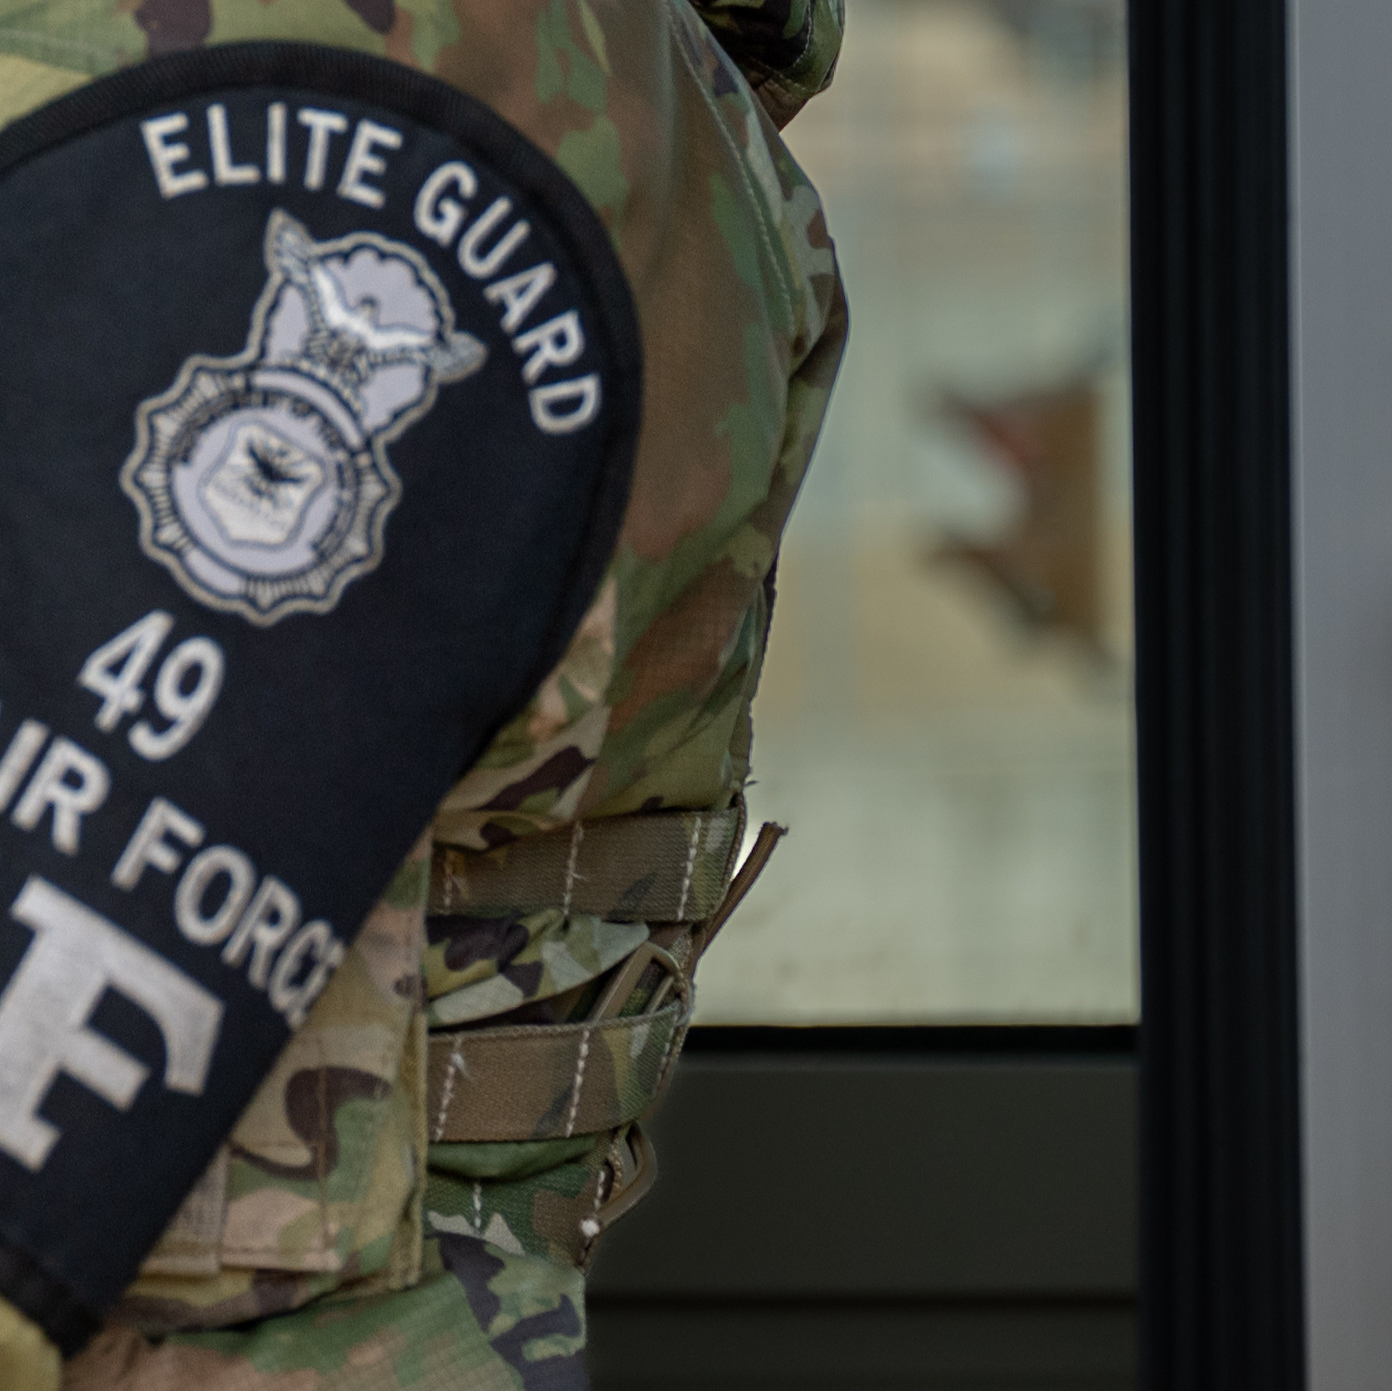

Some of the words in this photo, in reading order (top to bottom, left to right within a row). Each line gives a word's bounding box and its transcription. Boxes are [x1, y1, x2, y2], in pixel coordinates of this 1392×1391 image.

[141, 102, 404, 209] ELITE
[414, 161, 602, 435] GUARD
[77, 609, 225, 761] 49
